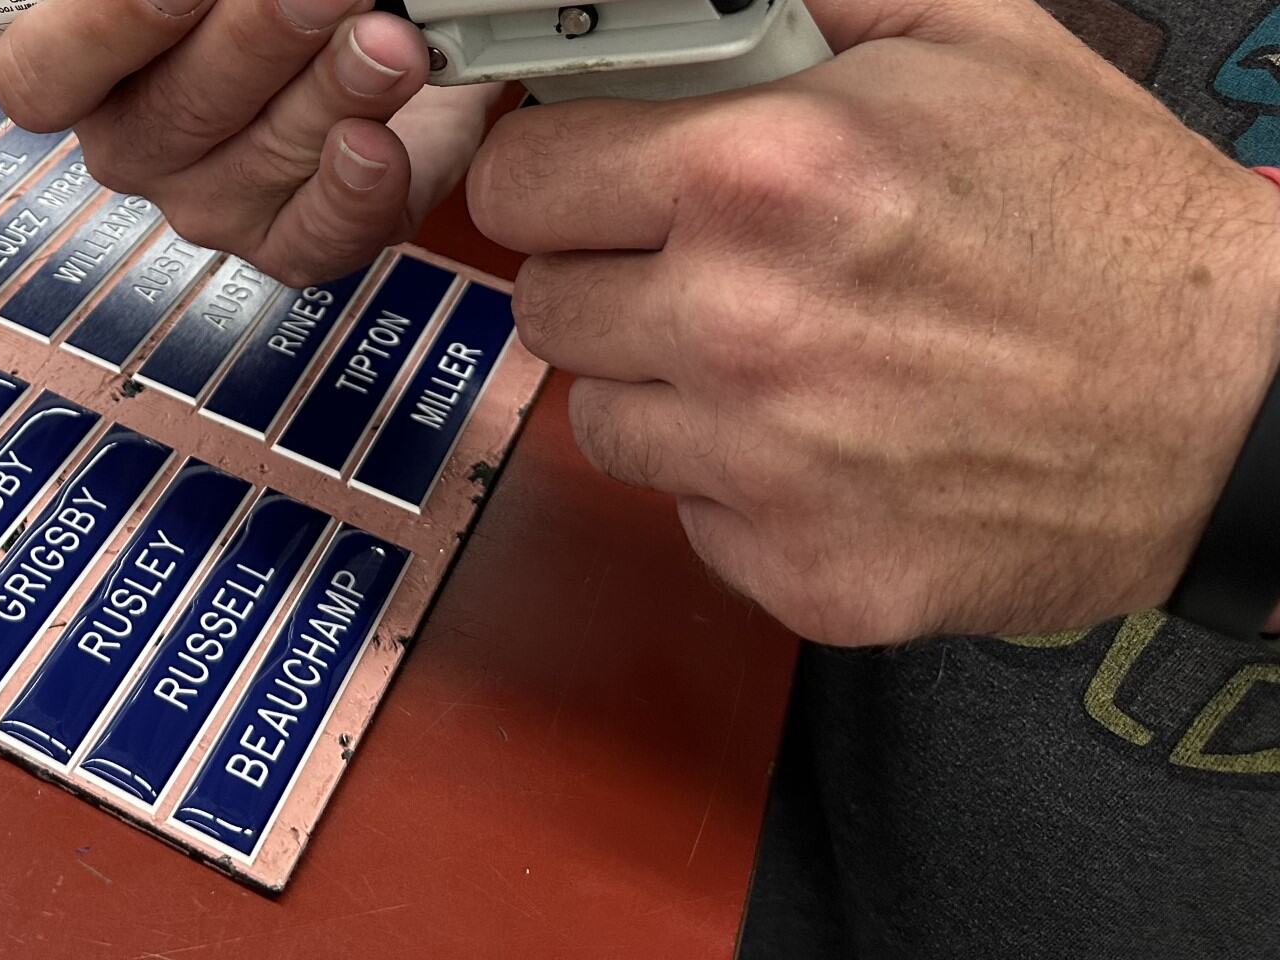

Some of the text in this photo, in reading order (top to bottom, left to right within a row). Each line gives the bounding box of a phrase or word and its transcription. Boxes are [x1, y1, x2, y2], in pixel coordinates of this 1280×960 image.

[53, 195, 152, 285] WILLIAMS
[268, 286, 334, 358] RINES
[336, 310, 410, 394] TIPTON
[410, 341, 483, 430] MILLER
[78, 530, 187, 664] RUSLEY
[153, 563, 275, 709] RUSSELL
[225, 568, 366, 789] BEAUCHAMP
